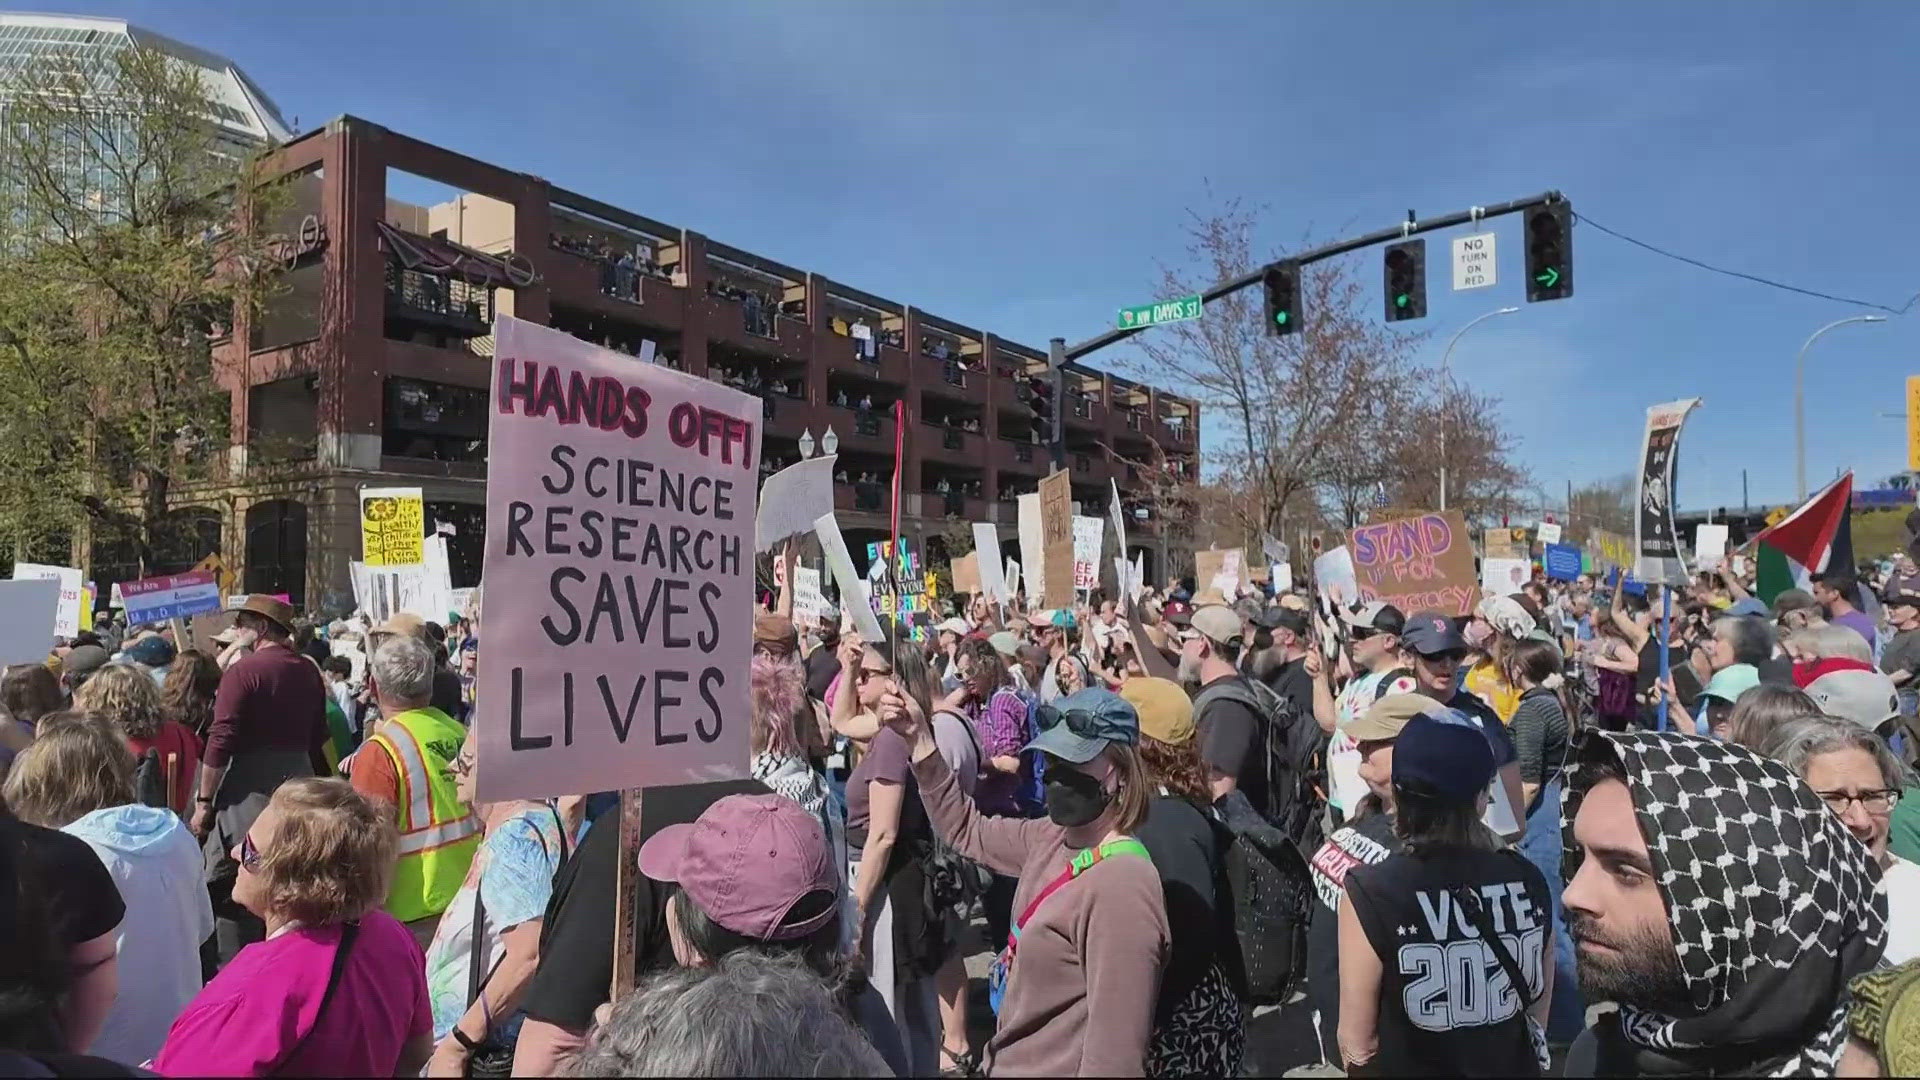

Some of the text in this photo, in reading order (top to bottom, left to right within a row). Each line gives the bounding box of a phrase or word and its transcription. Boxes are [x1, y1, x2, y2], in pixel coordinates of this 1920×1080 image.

[1461, 252, 1487, 262] TURN
[1464, 239, 1484, 251] NO
[1467, 265, 1481, 273] ON
[1465, 275, 1484, 285] RED
[1137, 301, 1198, 325] NW DAVIS ST
[499, 358, 651, 438] HANDS
[541, 445, 734, 520] SCIENCE
[506, 501, 740, 576] RESEARCH
[1353, 514, 1451, 566] STAND
[1392, 555, 1447, 583] FOR
[540, 566, 722, 654] SAVES
[510, 667, 725, 751] LIVES
[1398, 925, 1545, 1032] 2020
